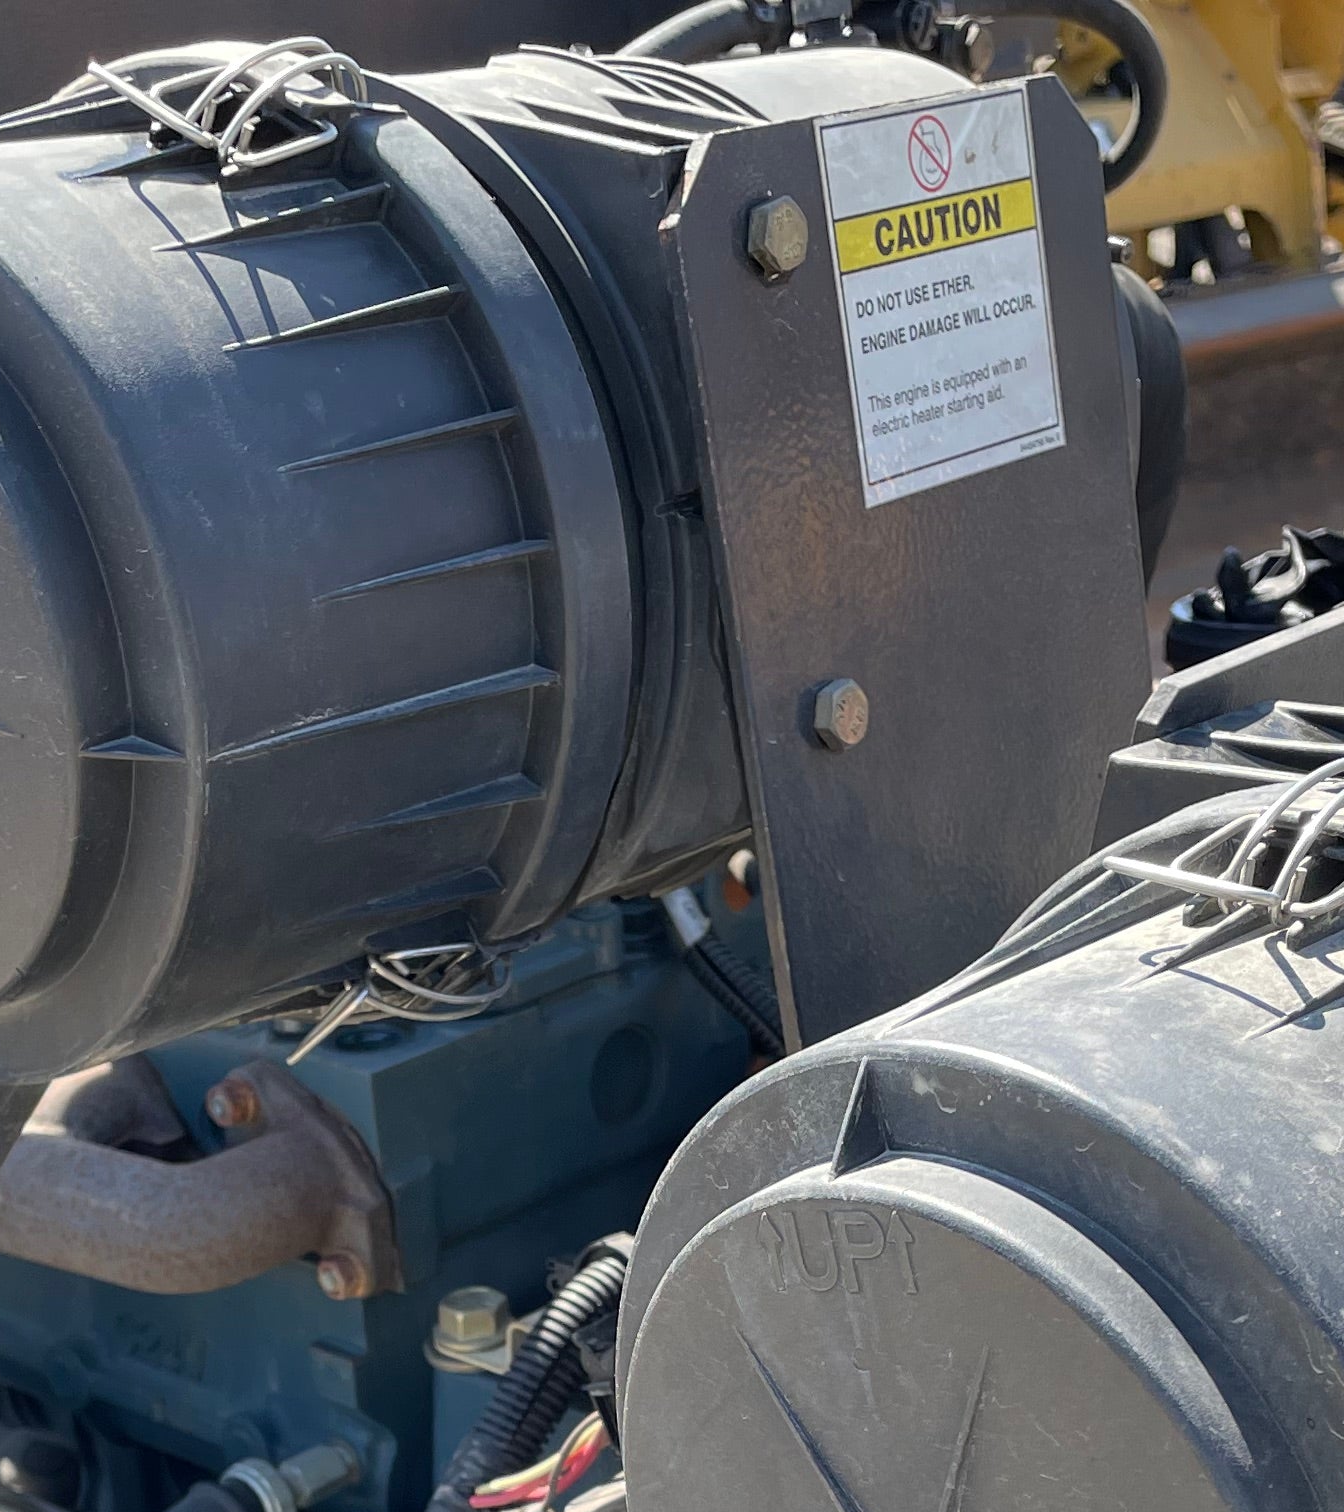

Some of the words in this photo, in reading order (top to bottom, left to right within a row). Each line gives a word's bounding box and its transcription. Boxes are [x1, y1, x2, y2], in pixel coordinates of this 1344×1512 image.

[874, 193, 1002, 256] CAUTION
[856, 299, 874, 319] DO
[877, 291, 902, 314] NOT
[905, 284, 930, 306] USE
[933, 274, 975, 299] ETHER.
[861, 327, 908, 354] ENGINE
[909, 313, 960, 342] DAMAGE
[962, 304, 991, 327] WILL
[993, 293, 1036, 319] OCCUR.
[868, 395, 892, 412] This
[894, 384, 930, 406] engine
[931, 378, 942, 395] is
[943, 363, 990, 392] equipped
[991, 358, 1013, 378] with
[1014, 355, 1028, 371] an
[872, 413, 911, 437] electric
[912, 404, 946, 426] heater
[946, 392, 985, 415] starting
[987, 384, 1006, 403] aid.
[782, 1209, 887, 1294] UP
